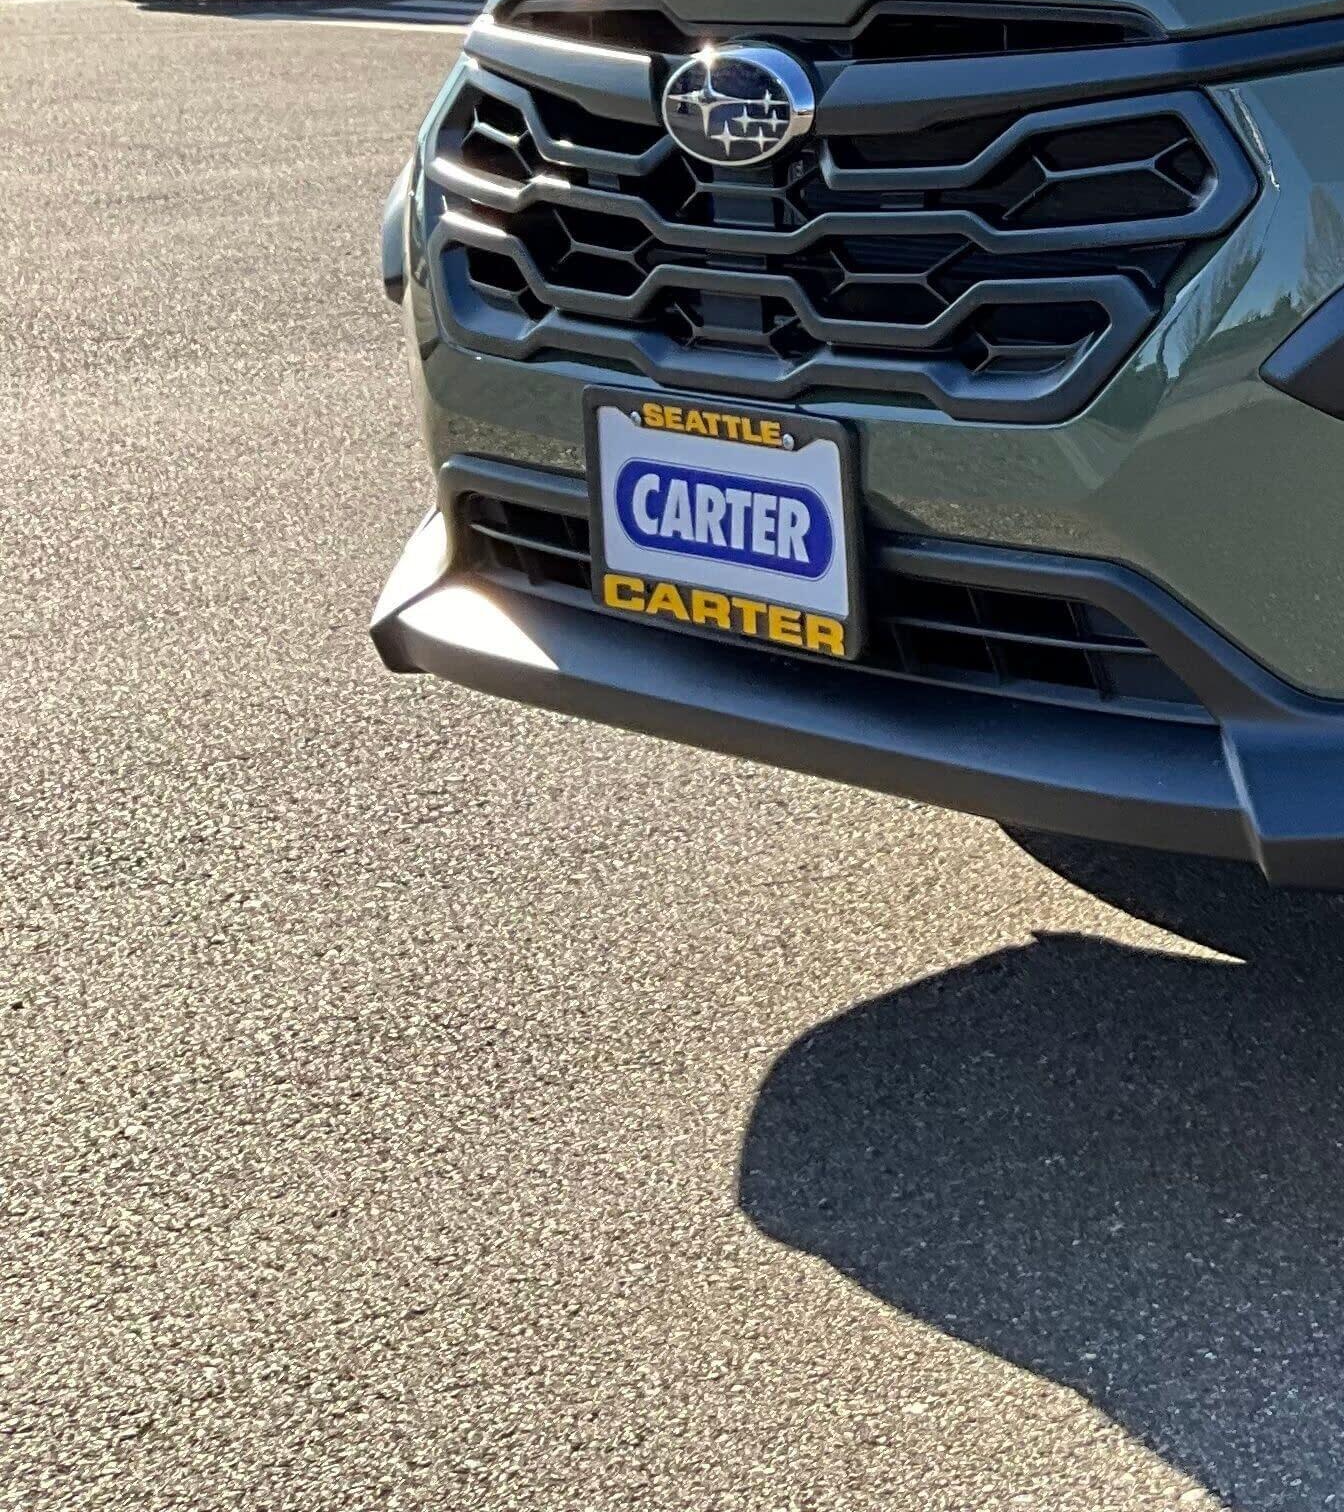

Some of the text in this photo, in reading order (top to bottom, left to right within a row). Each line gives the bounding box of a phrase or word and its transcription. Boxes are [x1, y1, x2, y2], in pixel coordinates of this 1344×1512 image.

[642, 402, 782, 447] SEATTLE
[632, 474, 811, 564] CARTER
[603, 573, 845, 656] CARTER
